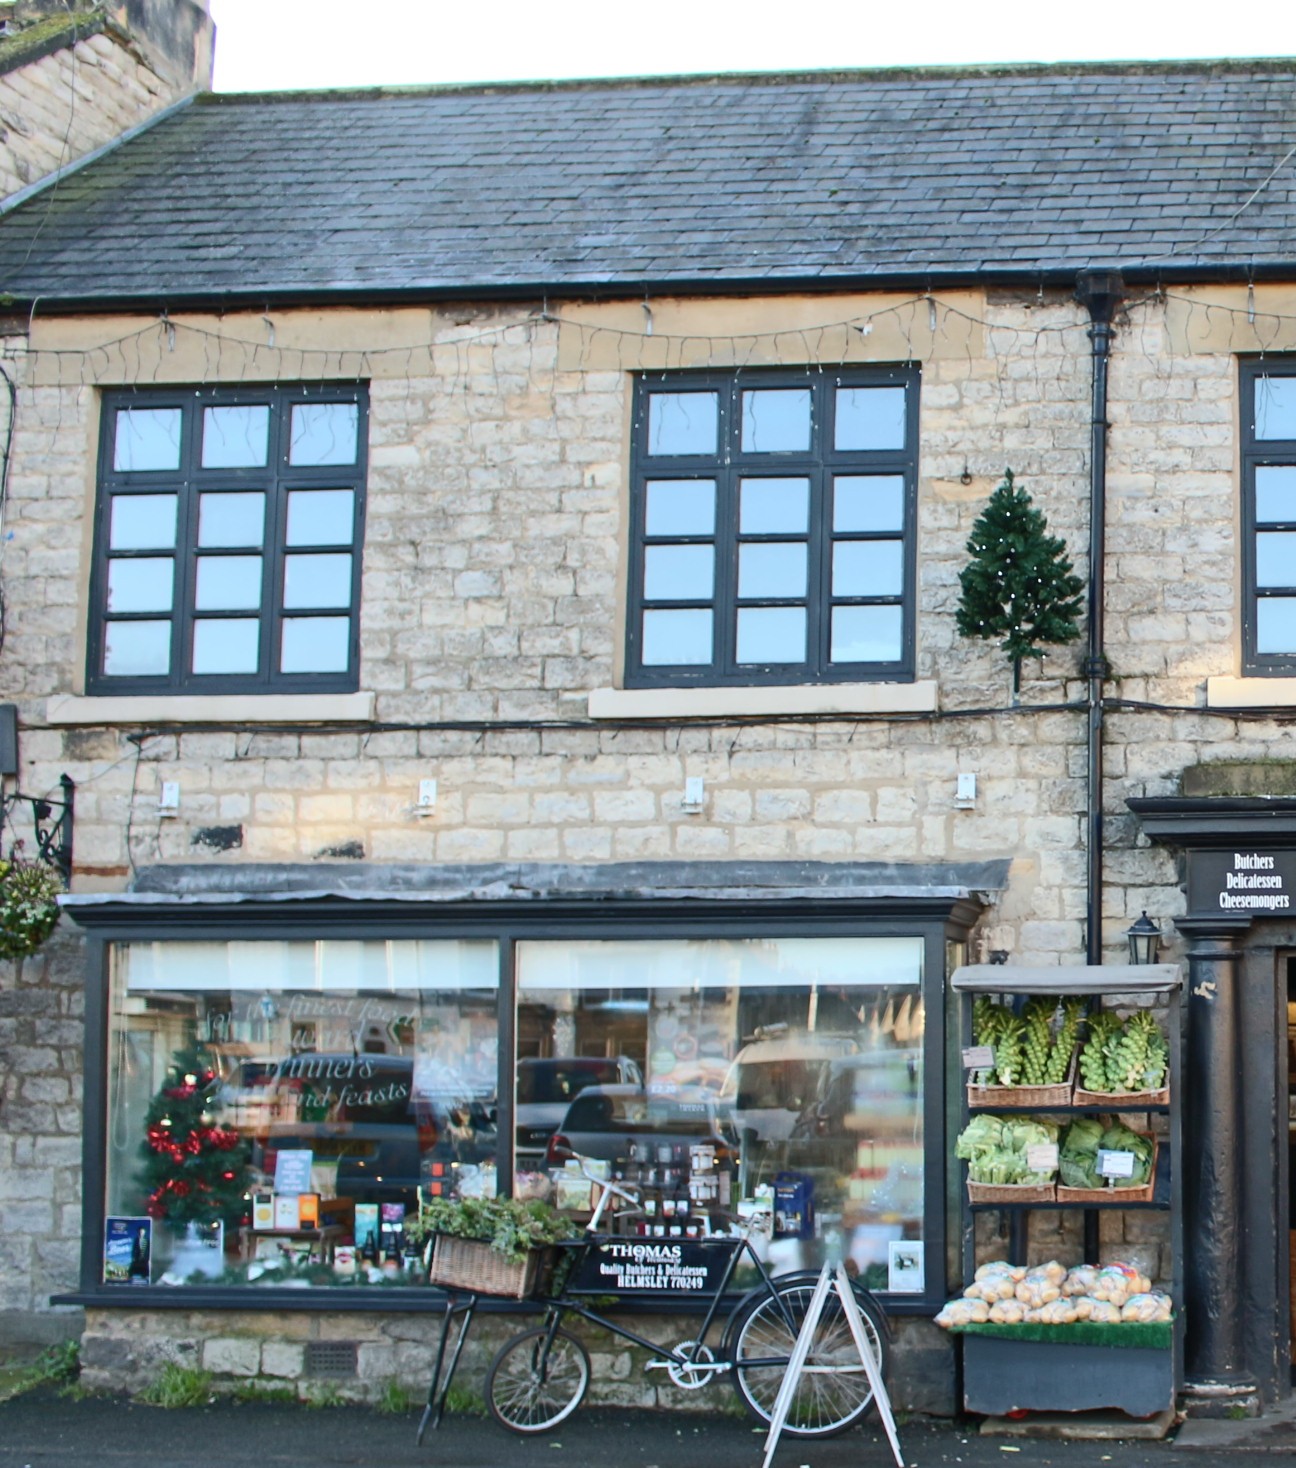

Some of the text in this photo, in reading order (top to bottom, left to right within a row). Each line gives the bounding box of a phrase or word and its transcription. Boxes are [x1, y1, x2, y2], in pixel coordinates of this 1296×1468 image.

[1234, 852, 1275, 870] Butchers
[1226, 872, 1282, 889] Delicatessen
[1219, 891, 1289, 911] Cheesemongers
[287, 995, 354, 1020] finest
[336, 1081, 408, 1113] feasts
[610, 1244, 682, 1258] THOMAS
[600, 1263, 708, 1277] Quality Butchers & Delicatessen
[618, 1275, 703, 1289] HELMSLEY 770249
